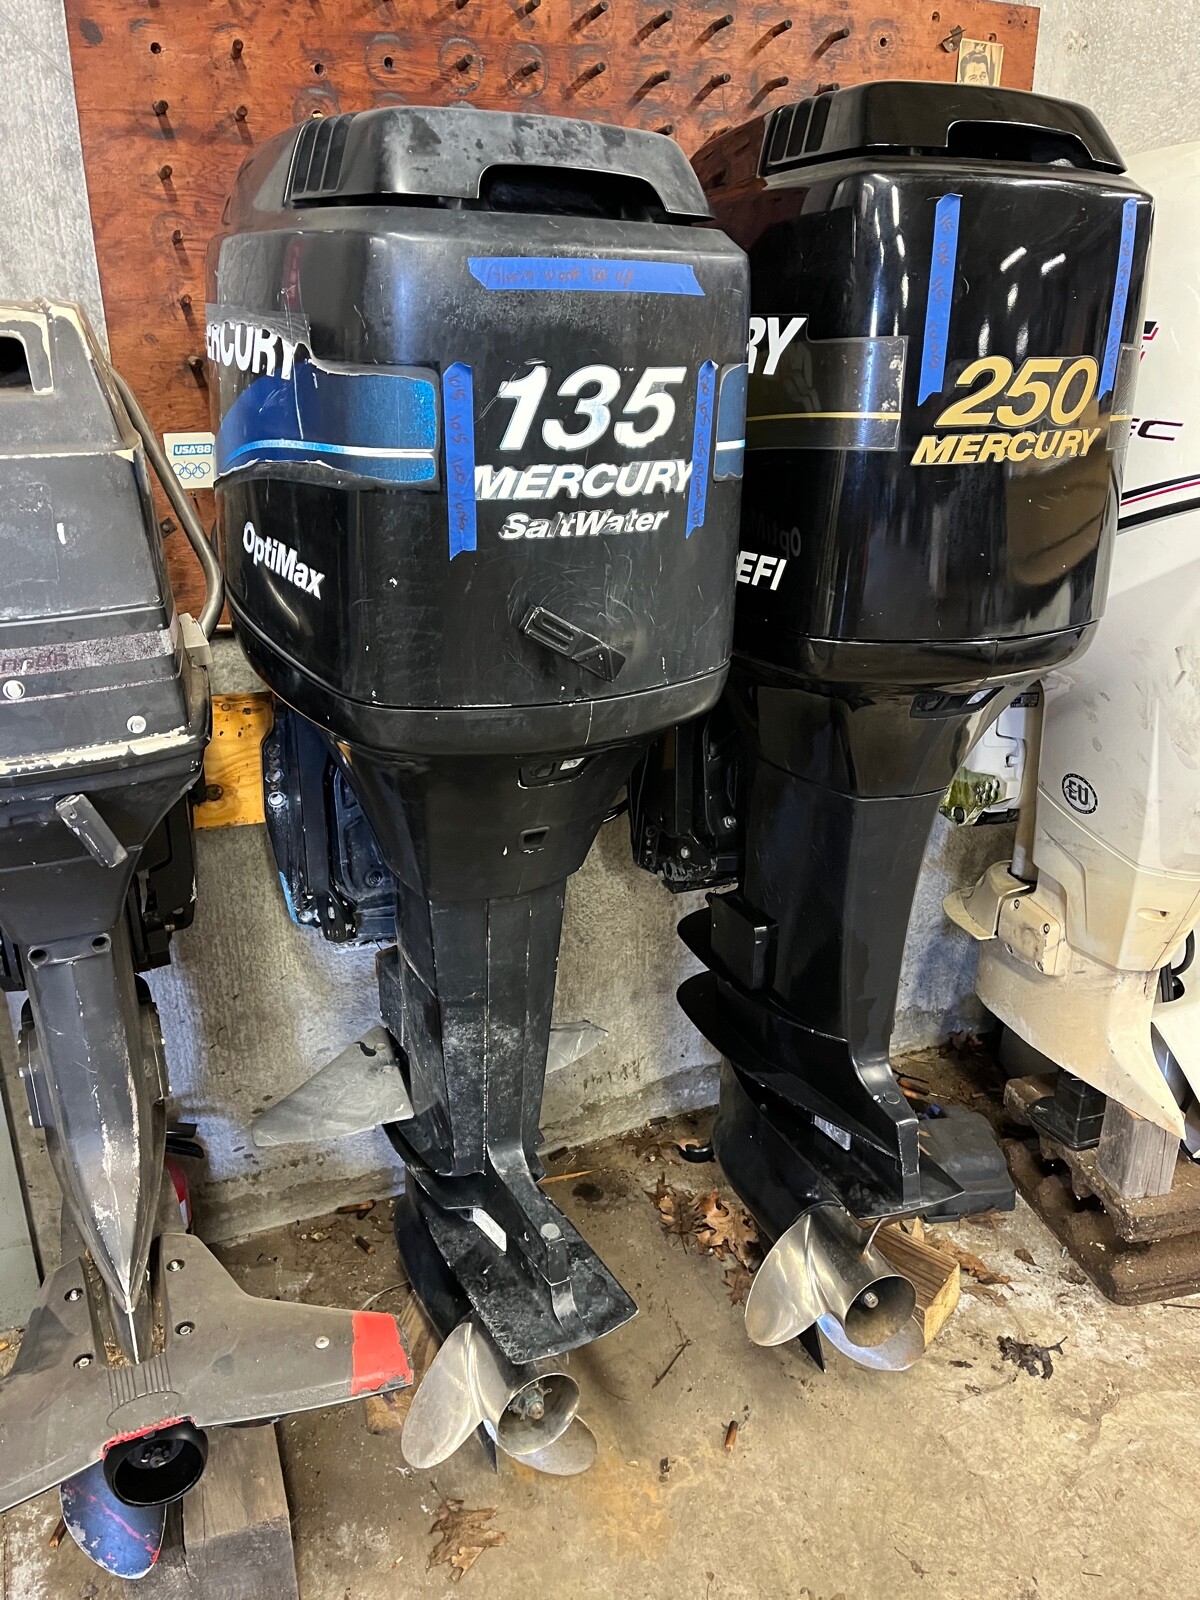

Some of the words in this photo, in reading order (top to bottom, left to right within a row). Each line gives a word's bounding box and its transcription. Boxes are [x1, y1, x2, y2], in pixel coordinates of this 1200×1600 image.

[748, 316, 807, 375] RY
[498, 364, 687, 451] 135
[936, 355, 1098, 427] 250
[174, 444, 212, 455] USA'88
[911, 427, 1101, 466] MERCURY
[474, 459, 693, 501] MERCURY
[498, 508, 670, 541] SaltWater
[242, 521, 326, 600] OptiMax
[736, 550, 788, 591] EFI
